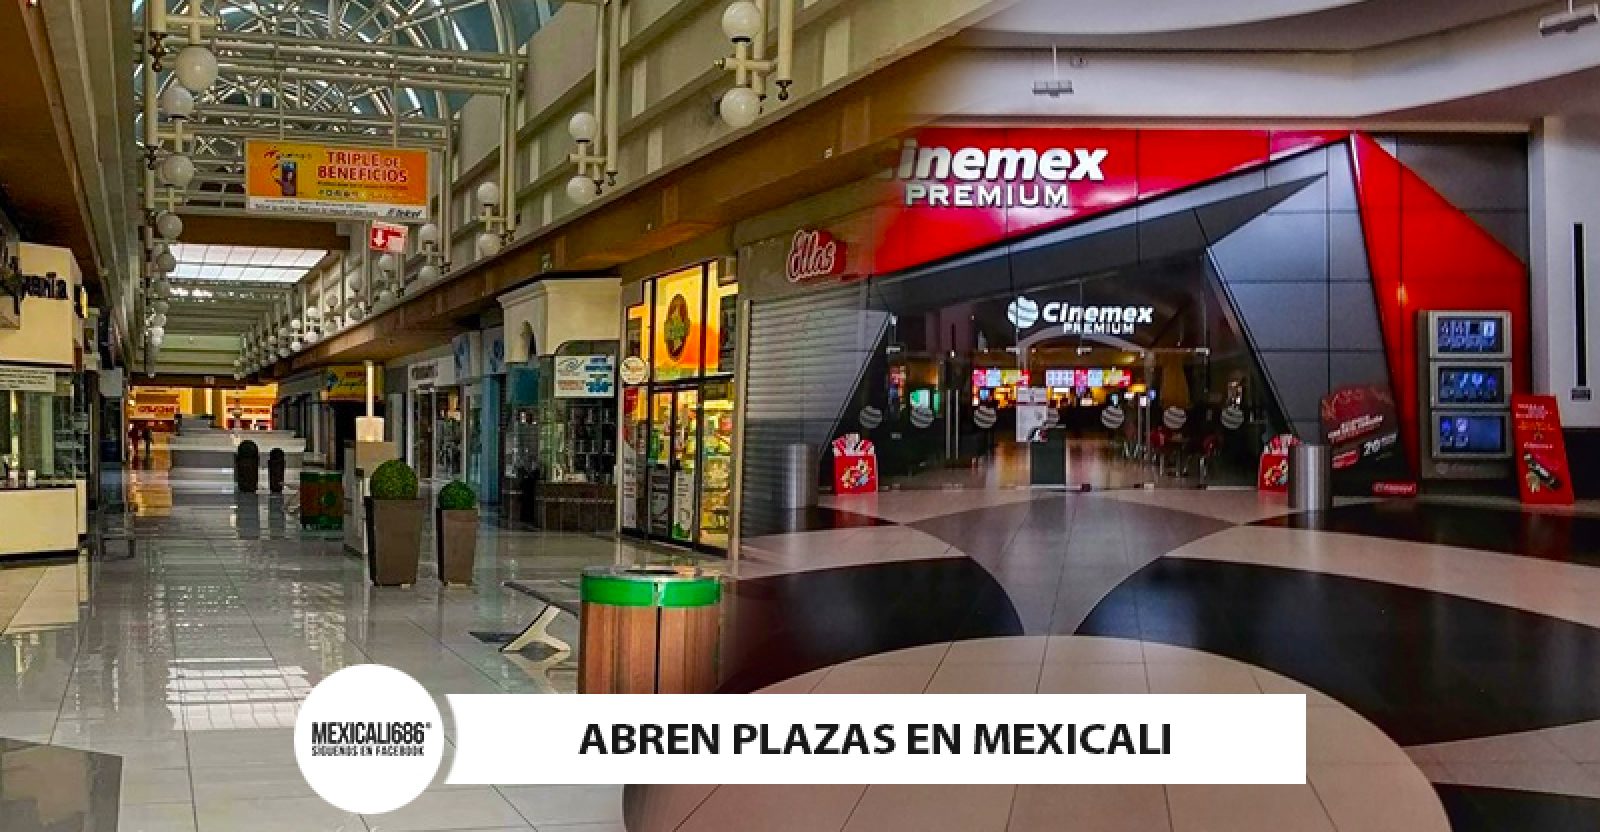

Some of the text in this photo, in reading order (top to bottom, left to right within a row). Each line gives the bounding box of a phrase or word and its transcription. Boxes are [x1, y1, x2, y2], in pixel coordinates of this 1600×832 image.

[326, 151, 380, 167] TRIPLE
[875, 138, 1109, 181] inemex
[317, 165, 409, 183] BENEFICIOS
[905, 184, 1069, 207] PREMIUM
[1042, 301, 1154, 323] Cinemex
[1062, 322, 1136, 335] PREMIUM
